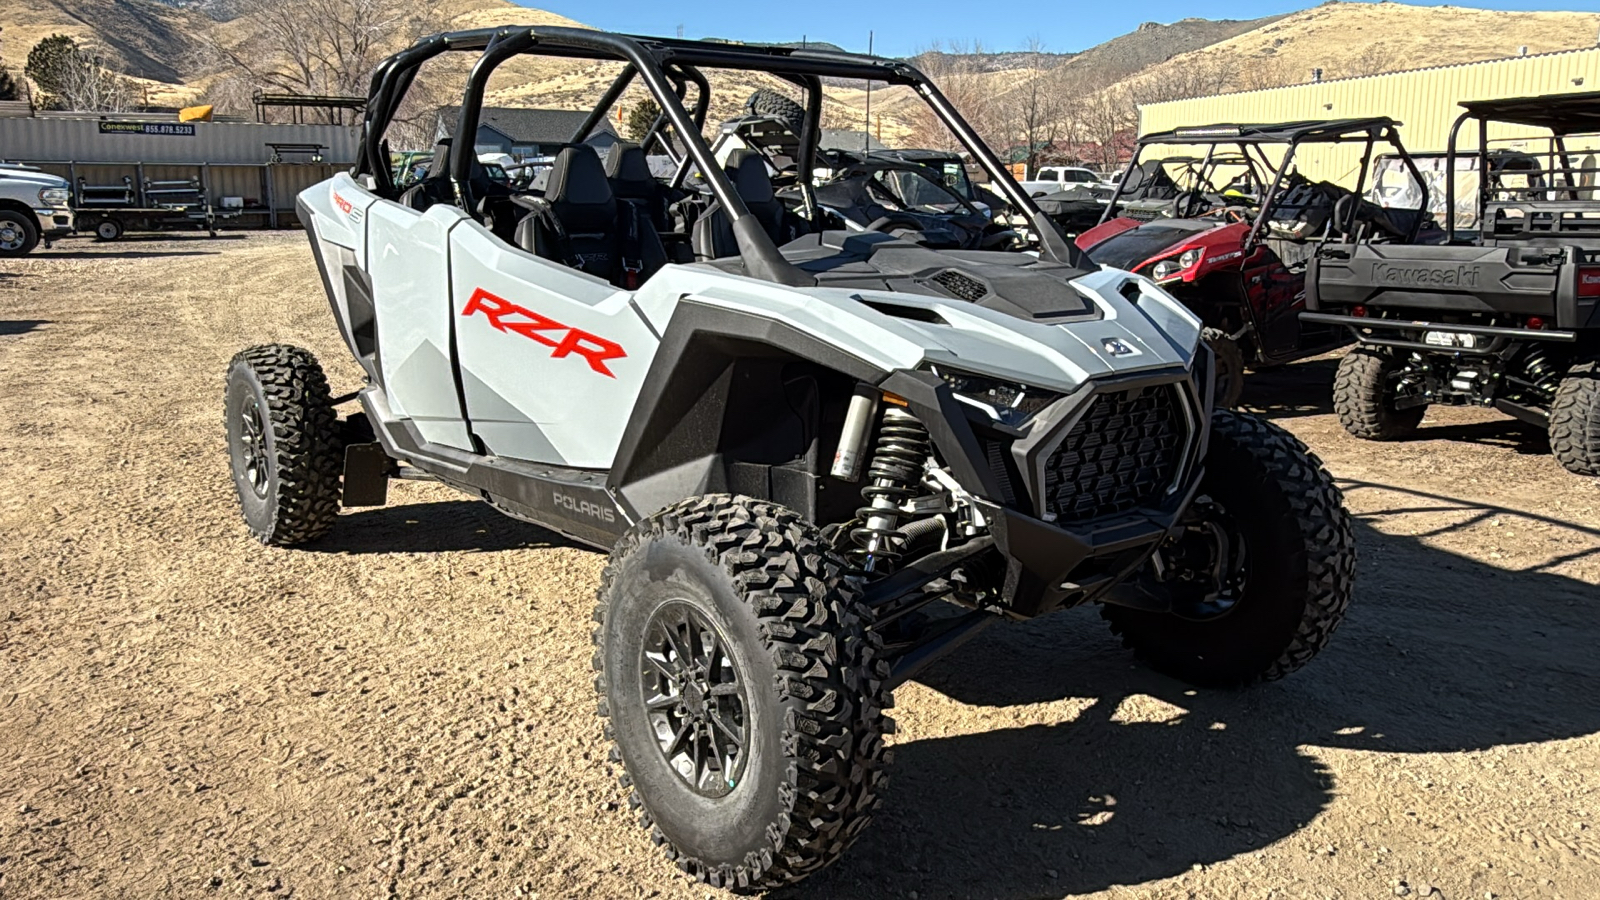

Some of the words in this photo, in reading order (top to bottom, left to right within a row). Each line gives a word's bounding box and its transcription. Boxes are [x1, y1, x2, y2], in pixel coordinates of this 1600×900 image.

[101, 122, 145, 131] Conexwest
[145, 125, 192, 134] 855.878.5233
[1371, 262, 1480, 286] Kawasaki
[461, 287, 628, 380] RZR
[553, 491, 616, 523] POLARIS
